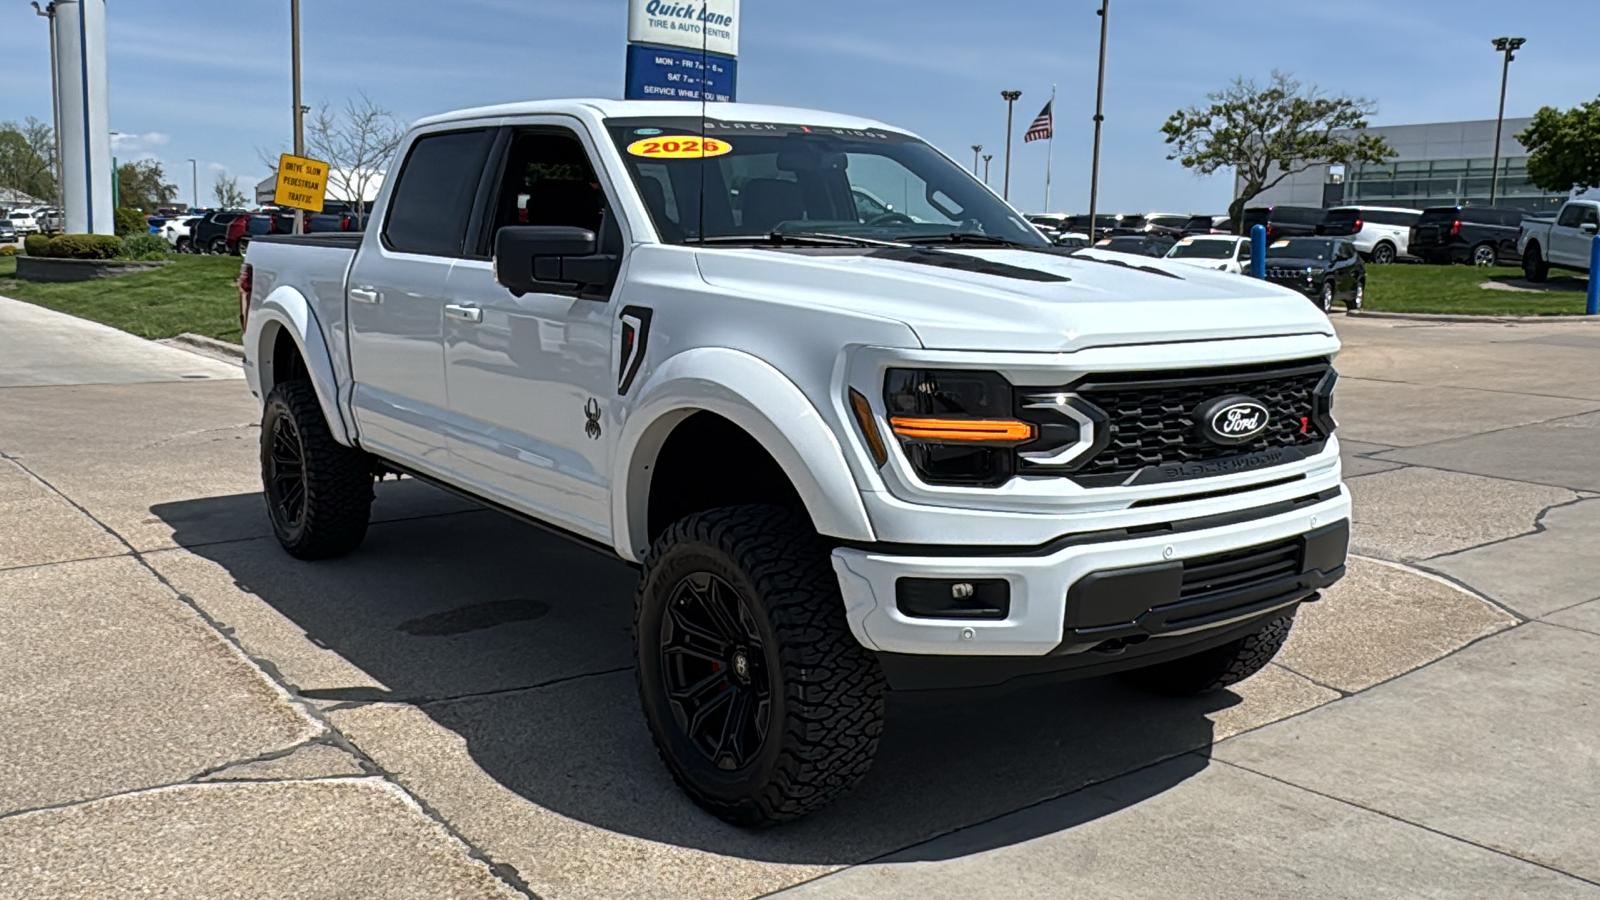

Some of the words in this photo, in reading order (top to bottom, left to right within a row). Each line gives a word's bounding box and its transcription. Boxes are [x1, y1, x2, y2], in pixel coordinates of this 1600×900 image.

[646, 0, 696, 19] Quick
[696, 8, 732, 27] Lane
[648, 18, 668, 29] TIRE
[670, 21, 676, 30] &
[678, 22, 700, 34] AUTO
[655, 56, 673, 66] MON
[682, 60, 693, 68] FRI
[667, 73, 681, 81] SAT
[644, 85, 676, 96] SERVICE
[678, 89, 699, 99] WHILE
[704, 122, 776, 130] BLACK
[831, 129, 887, 138] WIDOW
[642, 141, 719, 154] 2026
[285, 162, 303, 173] DRIVE
[305, 166, 321, 176] SLOW
[283, 176, 319, 190] PEDESTRIAN
[288, 191, 312, 204] TRAFFIC
[1223, 408, 1260, 433] Ford
[1166, 463, 1229, 479] BLACK
